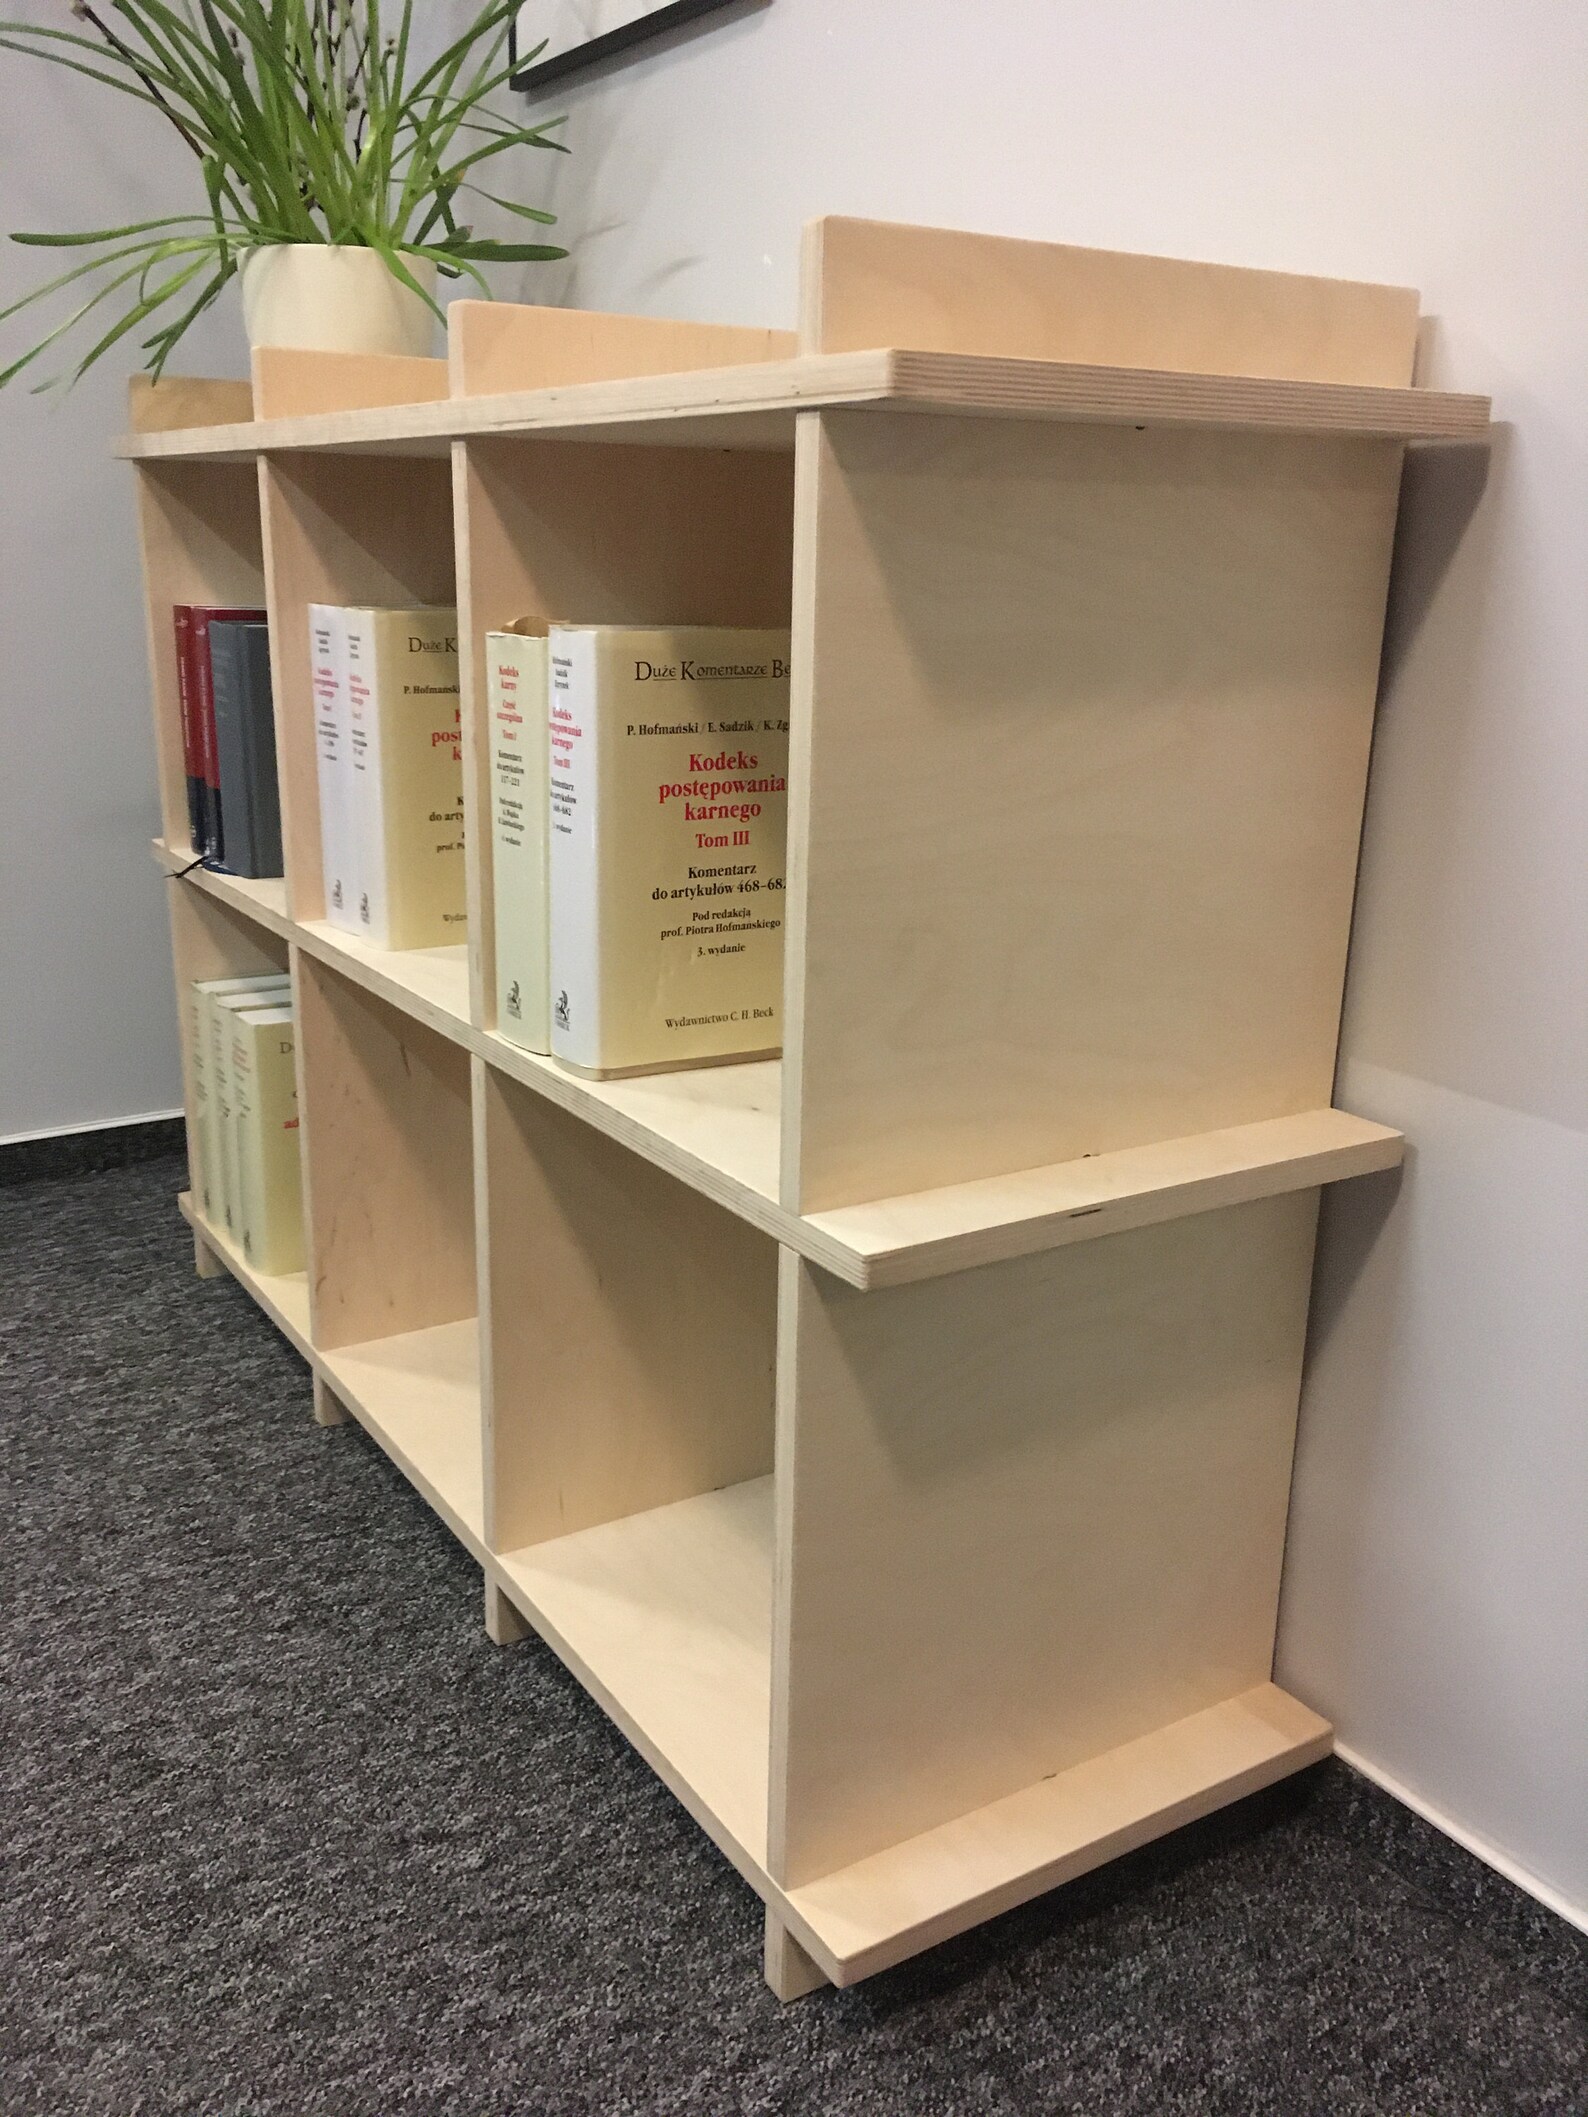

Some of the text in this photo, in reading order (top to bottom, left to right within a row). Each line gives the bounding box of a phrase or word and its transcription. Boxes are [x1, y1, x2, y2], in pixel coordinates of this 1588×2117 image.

[635, 660, 677, 681] Duże
[627, 725, 636, 736] P.
[639, 722, 699, 736] Hofmański
[708, 722, 717, 733] E.
[719, 720, 754, 733] Sadzik
[764, 720, 774, 731] K.
[689, 750, 759, 772] Kodeks
[659, 774, 786, 804] postępowania
[684, 802, 762, 823] karnego
[695, 830, 750, 848] Tom III
[688, 864, 757, 879] Komentarz
[652, 887, 668, 901] do
[671, 882, 734, 901] artykułów
[692, 907, 751, 921] Pod redakcją
[660, 927, 684, 941] prof.
[685, 925, 714, 936] Piotra
[697, 943, 746, 957] 3. wydanie
[665, 1013, 729, 1030] Wydawnictwo
[730, 1011, 739, 1021] C.
[753, 1006, 774, 1019] Beck
